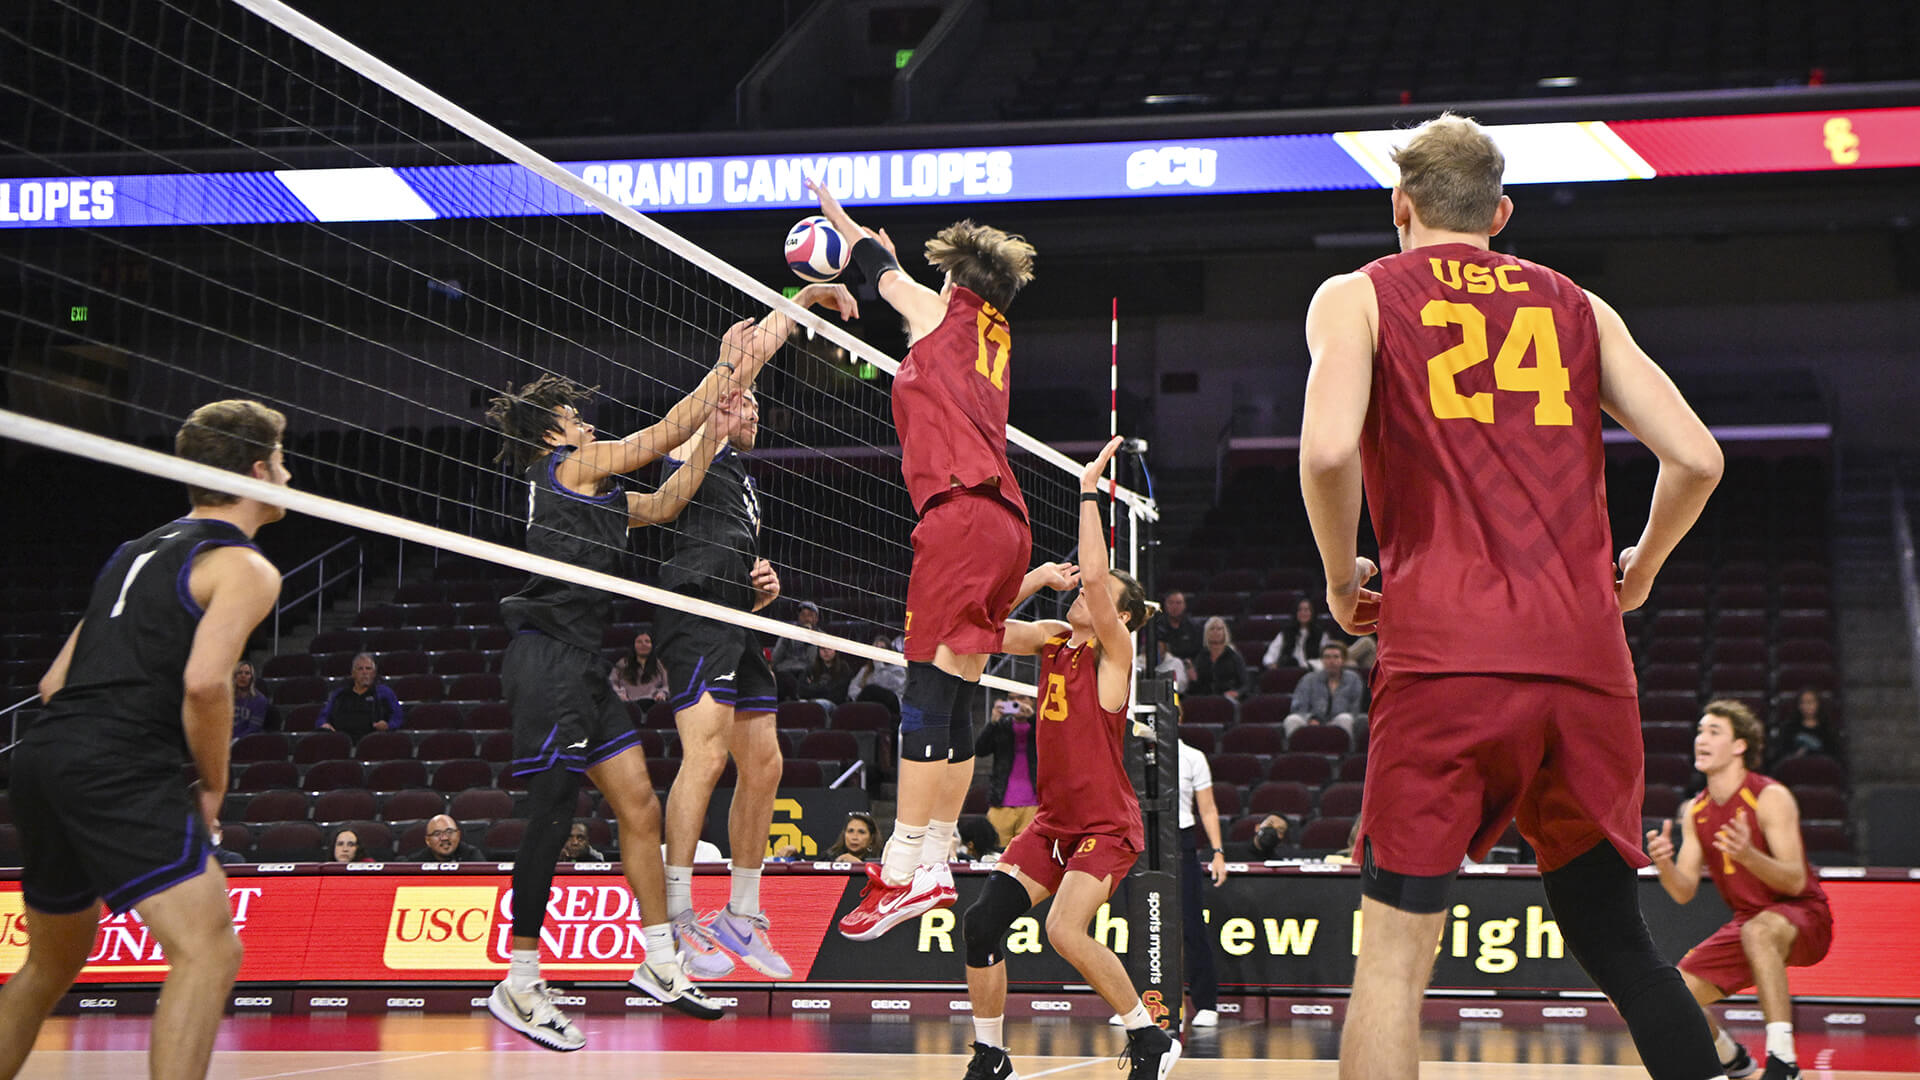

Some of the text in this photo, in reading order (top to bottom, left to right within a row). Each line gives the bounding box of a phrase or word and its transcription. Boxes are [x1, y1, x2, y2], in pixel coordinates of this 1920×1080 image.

[583, 150, 1013, 206] GRAND CANYON LOPES
[1126, 147, 1218, 190] GCU
[0, 181, 115, 221] LOPES
[1428, 257, 1530, 294] USC
[71, 306, 88, 321] EXIT
[975, 310, 1011, 391] 17
[1419, 299, 1574, 427] 24
[110, 549, 158, 618] 1
[1039, 672, 1068, 721] 13
[1077, 838, 1097, 853] 13
[396, 908, 489, 942] USC
[917, 902, 1129, 954] Rah
[1202, 909, 1319, 955] ew
[1147, 891, 1162, 984] sports imports
